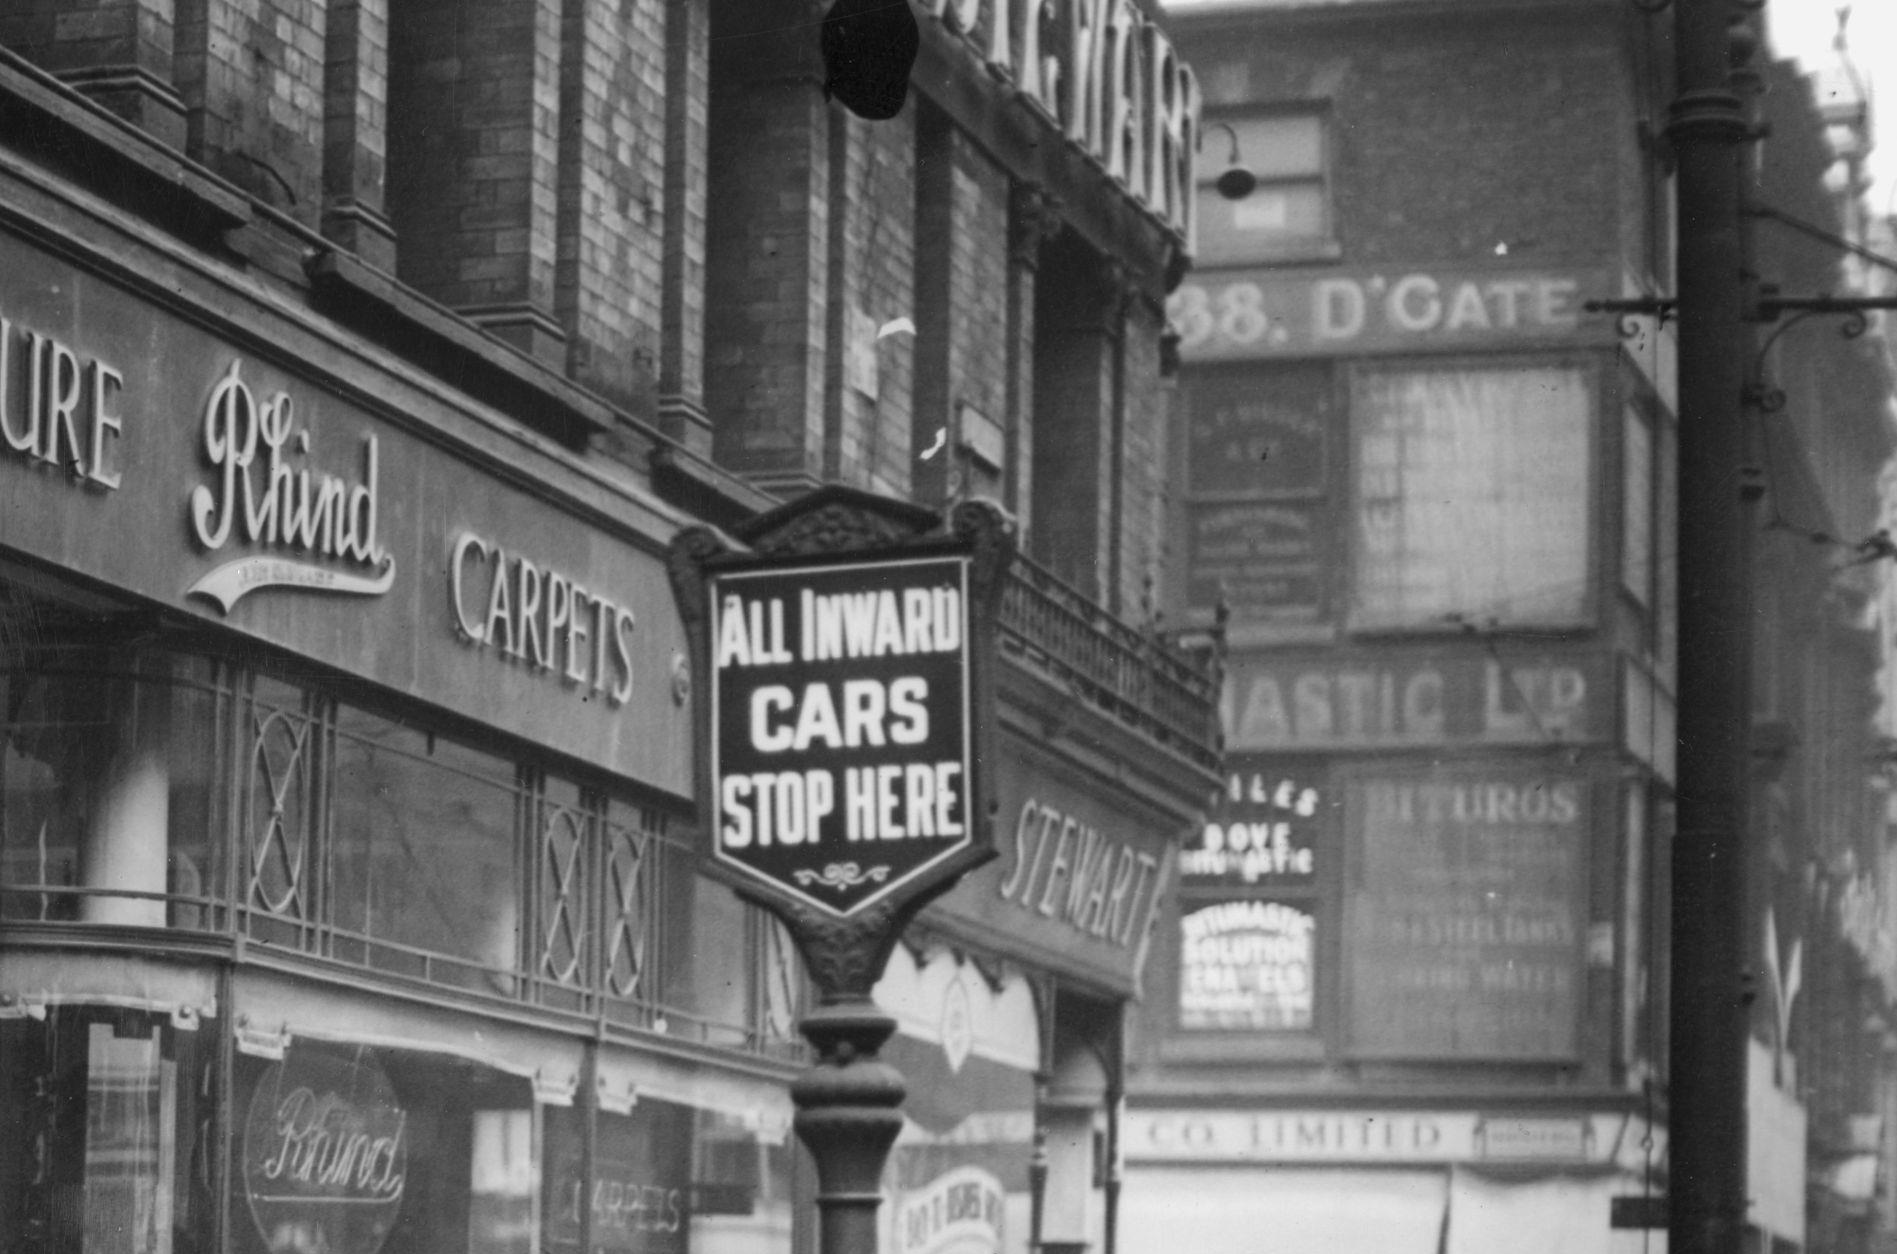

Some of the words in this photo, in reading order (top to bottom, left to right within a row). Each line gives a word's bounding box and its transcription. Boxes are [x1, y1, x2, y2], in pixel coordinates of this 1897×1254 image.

[1312, 274, 1578, 340] D'GATE
[191, 358, 395, 566] Rhind
[451, 531, 635, 704] CARPETS
[718, 594, 793, 667] ALL
[801, 587, 961, 661] INWARD
[750, 676, 929, 752] CARS
[721, 769, 834, 848] STOP
[845, 761, 964, 841] HERE
[265, 1086, 404, 1193] Rhind
